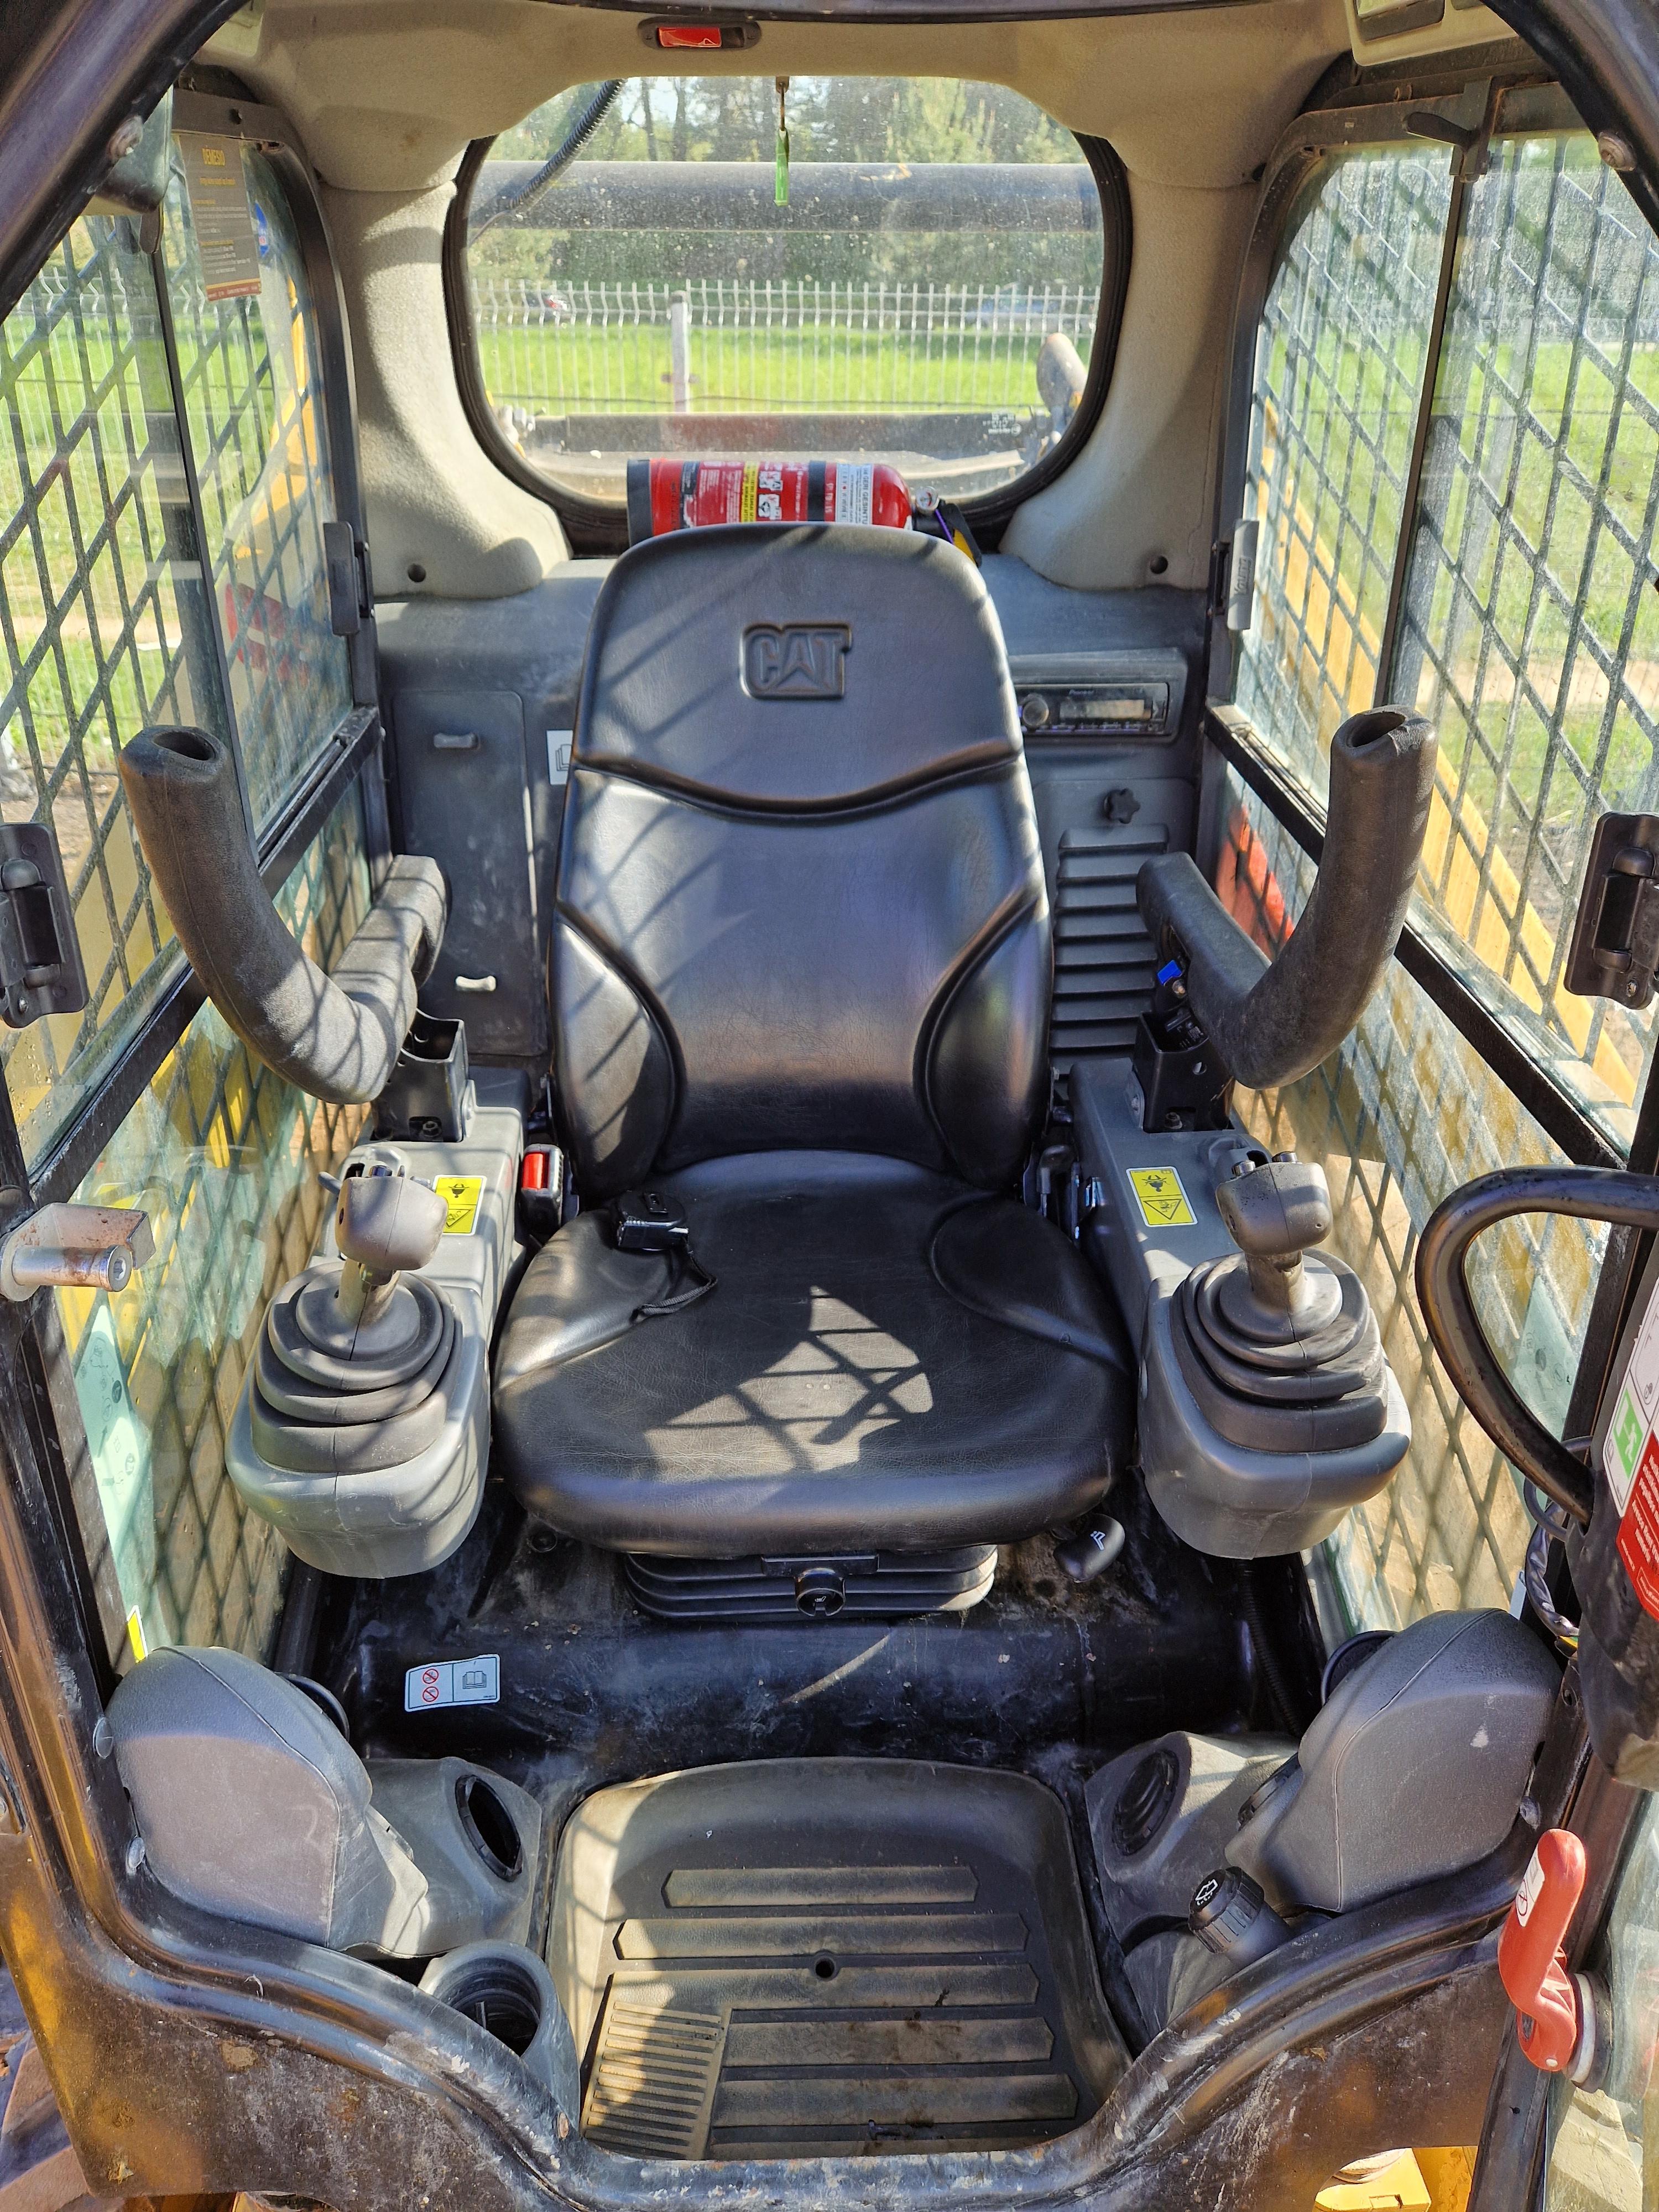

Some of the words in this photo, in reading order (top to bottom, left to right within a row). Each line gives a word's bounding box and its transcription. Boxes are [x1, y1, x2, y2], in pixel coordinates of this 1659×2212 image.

[747, 632, 843, 692] CAT
[1632, 1499, 1645, 1530] Avesco
[1643, 1525, 1653, 1548] Rent
